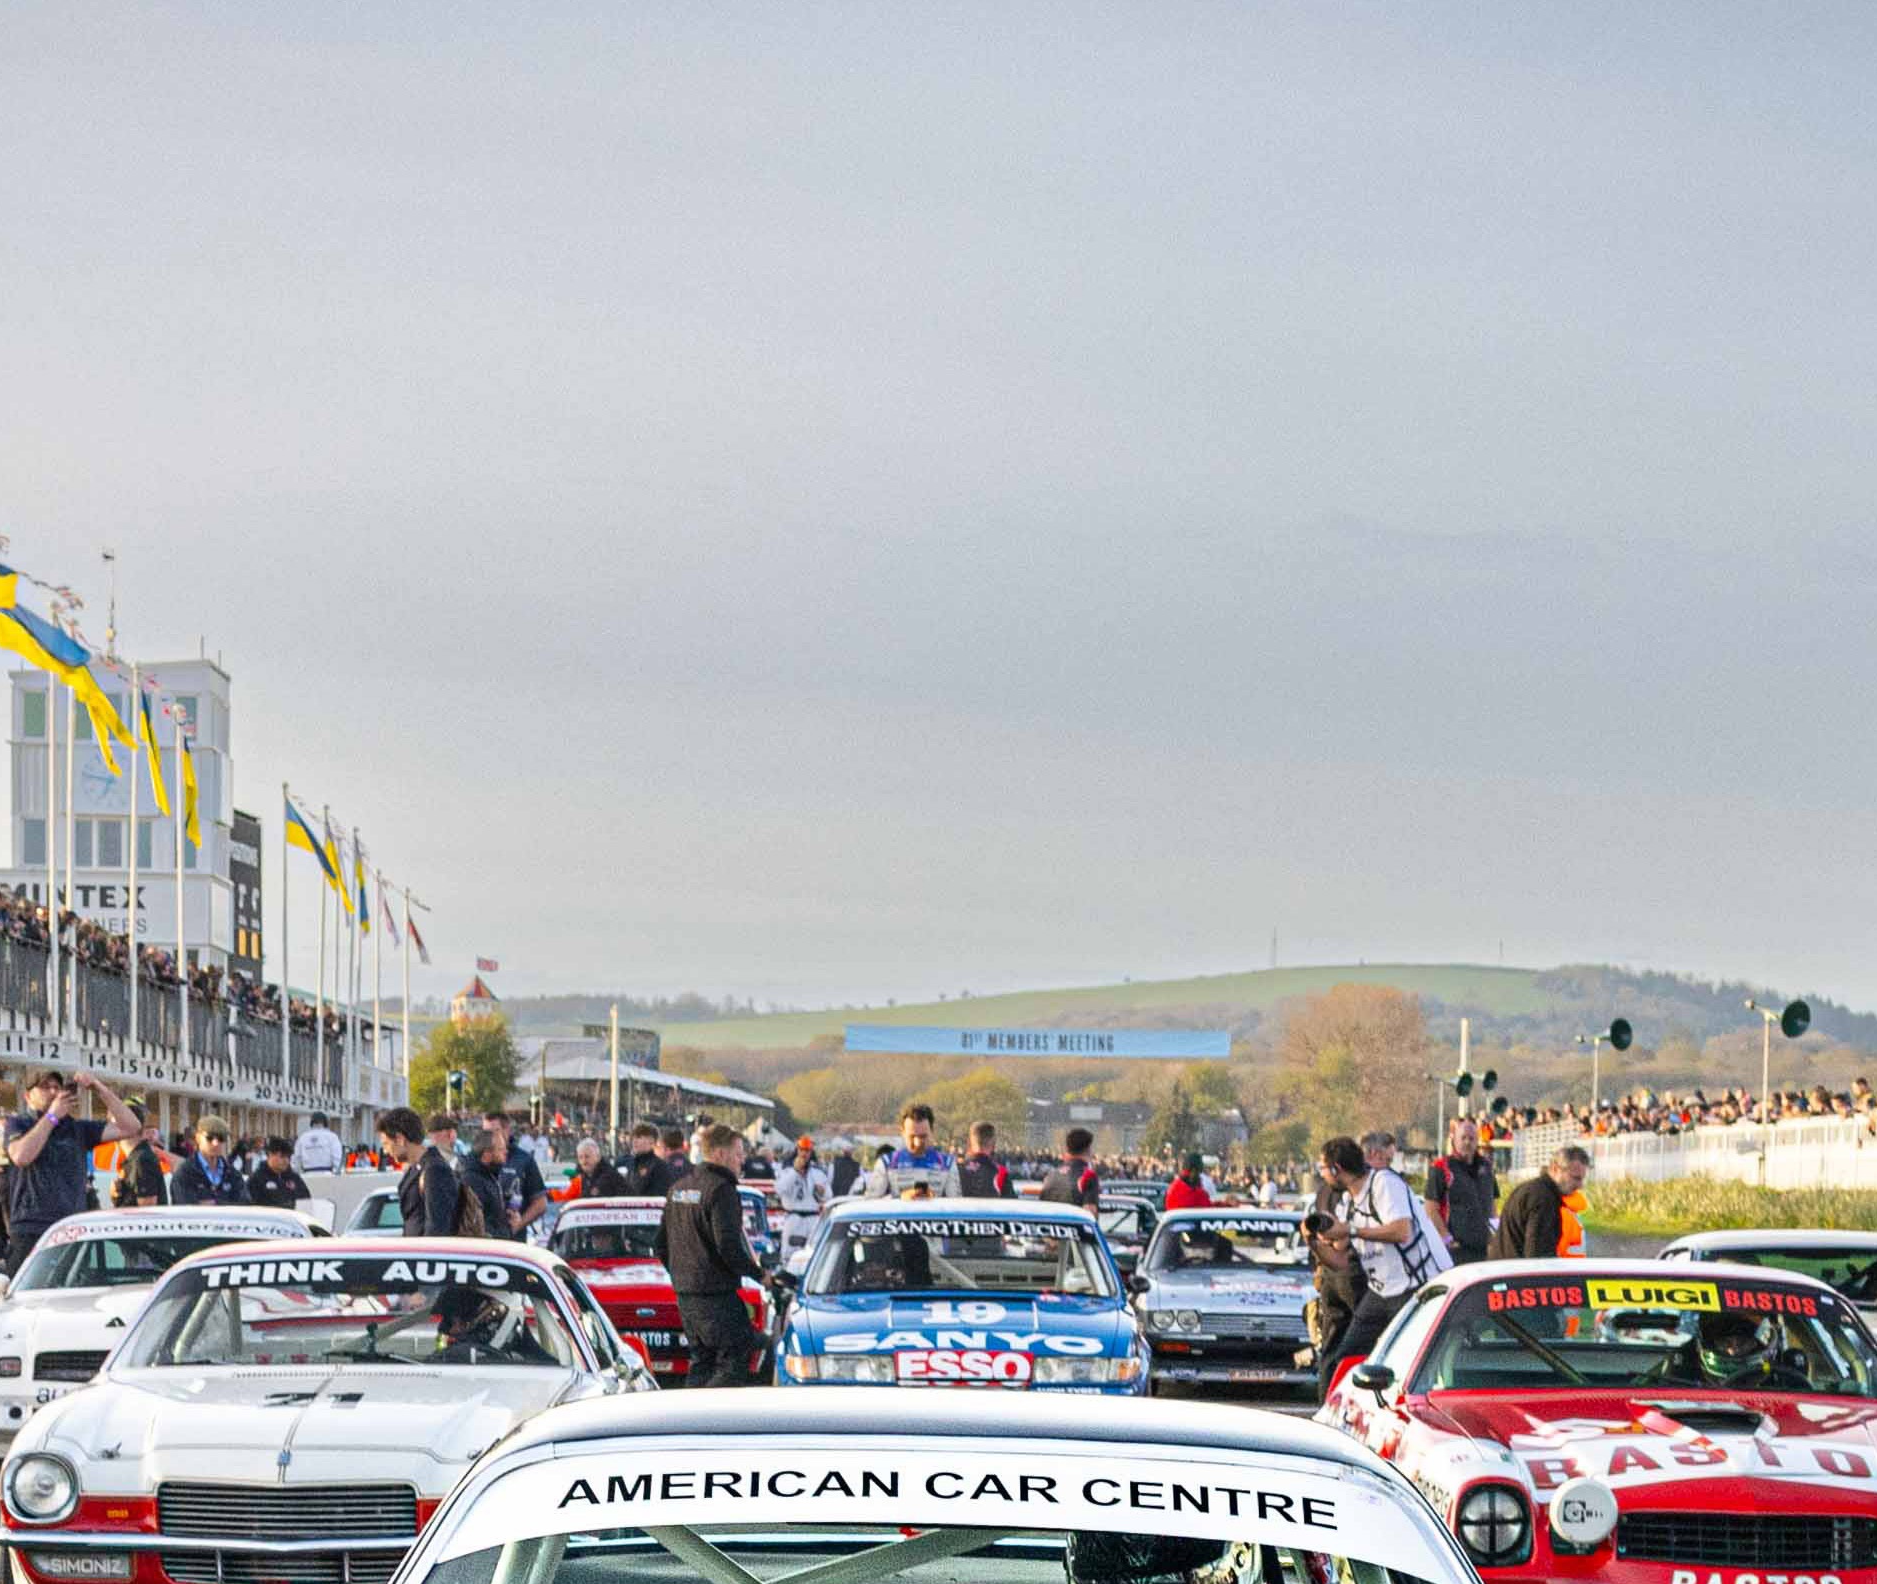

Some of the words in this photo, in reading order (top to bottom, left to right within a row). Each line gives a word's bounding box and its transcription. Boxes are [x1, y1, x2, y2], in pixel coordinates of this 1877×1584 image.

[6, 1036, 24, 1053] 11
[39, 1042, 59, 1059] 12
[1058, 1033, 1114, 1051] MEETING
[89, 1052, 107, 1069] 14
[120, 1058, 138, 1075] 15
[146, 1063, 164, 1079] 16
[172, 1068, 188, 1084] 17
[196, 1073, 213, 1089] 18
[219, 1079, 235, 1093] 19
[255, 1084, 272, 1100] 20
[948, 1219, 1005, 1237] THEN
[1200, 1220, 1295, 1233] MANNS
[201, 1260, 344, 1288] THINK
[381, 1260, 510, 1287] AUTO
[1486, 1286, 1584, 1312] BASTOS
[1596, 1288, 1713, 1305] LUIGI
[1724, 1289, 1819, 1317] BASTOS
[921, 1301, 1007, 1325] 19
[823, 1330, 1104, 1355] SANYO
[897, 1351, 1032, 1381] ESSO
[558, 1470, 900, 1509] AMERICAN
[925, 1472, 1060, 1504] CAR
[1082, 1478, 1339, 1531] CENTRE
[51, 1556, 123, 1575] SIMONIZ
